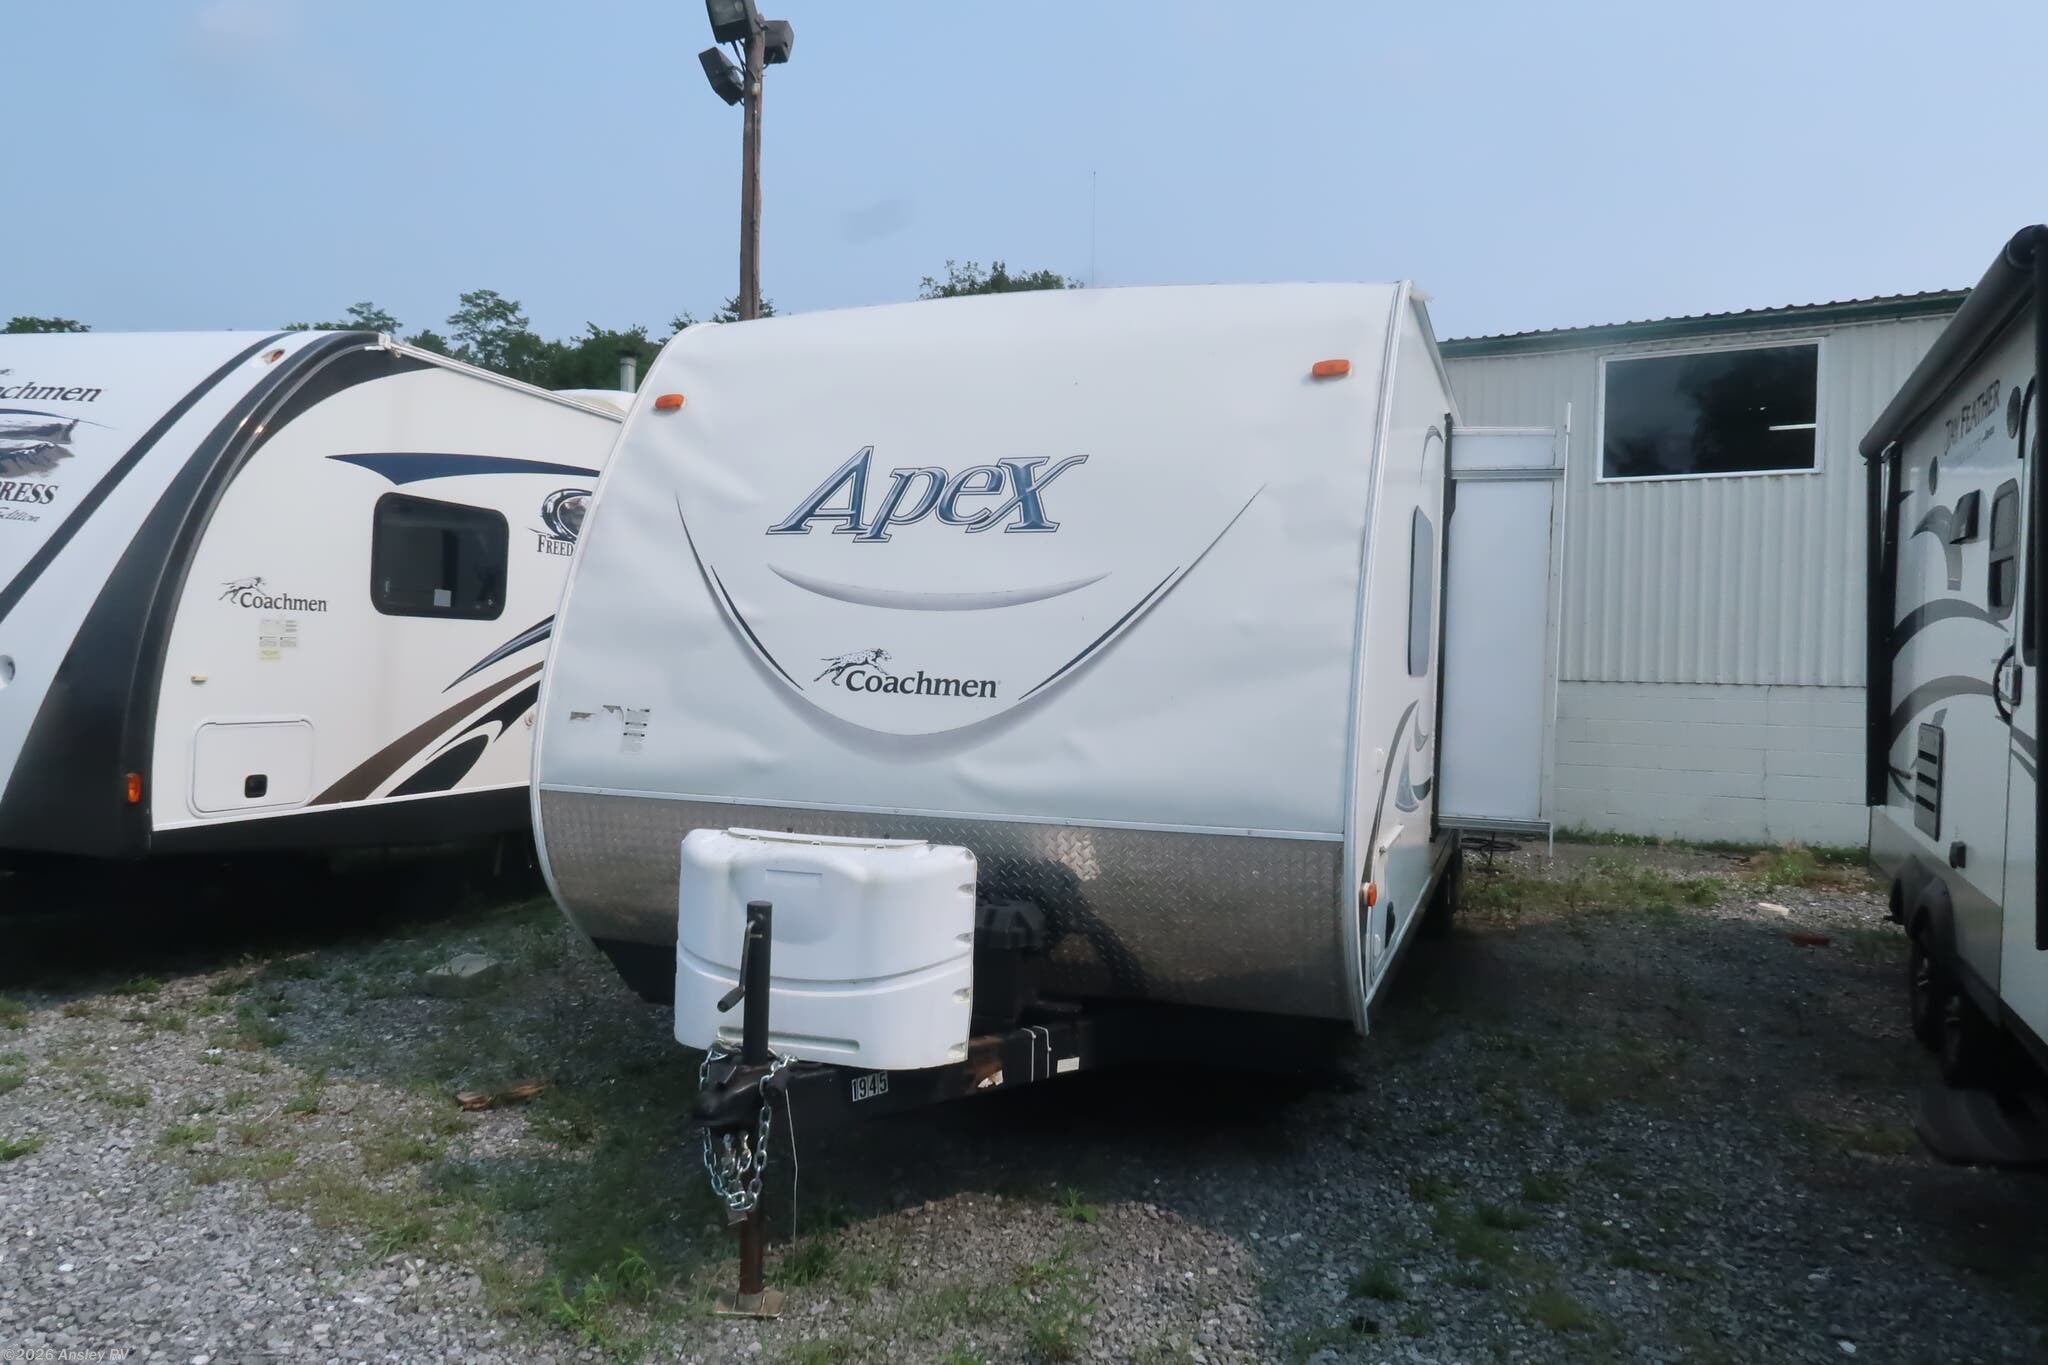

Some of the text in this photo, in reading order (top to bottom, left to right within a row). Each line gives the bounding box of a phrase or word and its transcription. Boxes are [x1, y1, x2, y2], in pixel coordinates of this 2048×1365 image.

[0, 381, 102, 402] chmen
[0, 480, 58, 505] RESS
[536, 533, 575, 557] FREED
[240, 592, 327, 612] Coachmen
[846, 669, 997, 698] Coachmen
[851, 1070, 888, 1102] 1945
